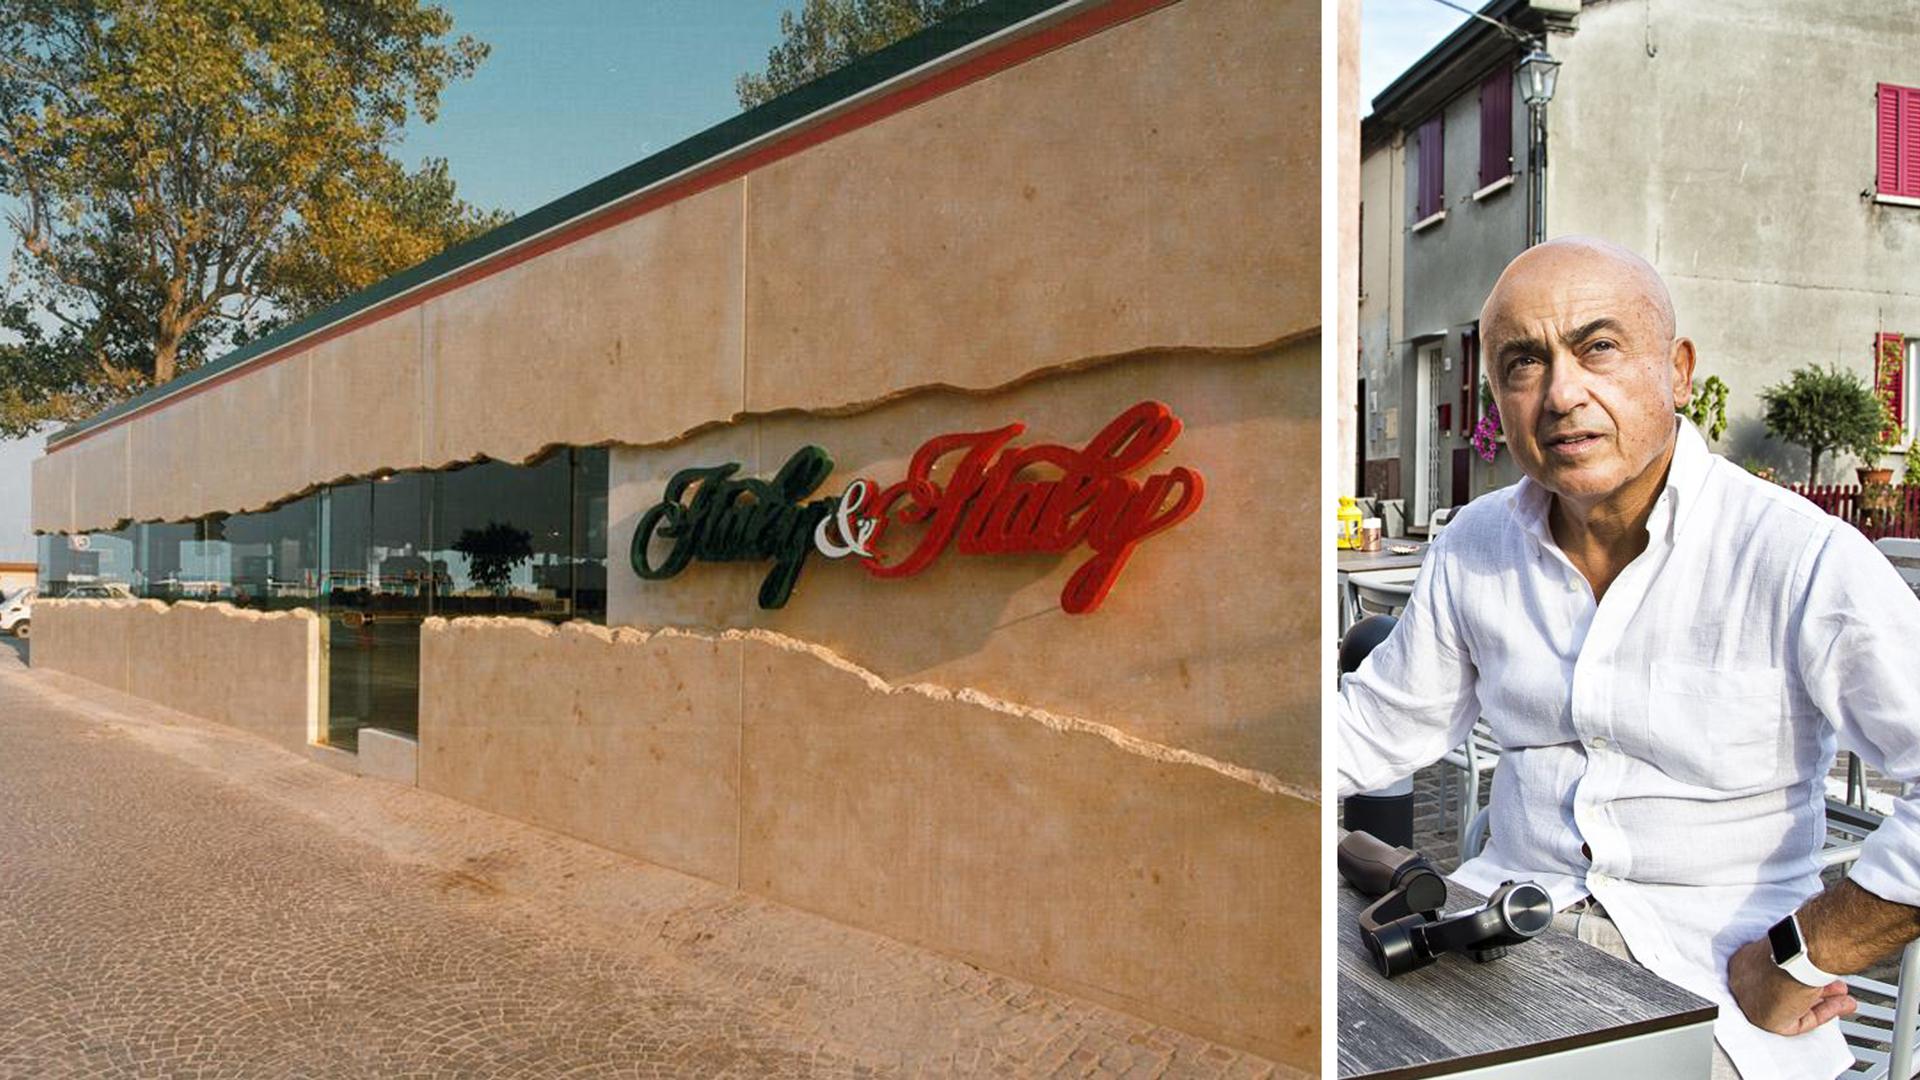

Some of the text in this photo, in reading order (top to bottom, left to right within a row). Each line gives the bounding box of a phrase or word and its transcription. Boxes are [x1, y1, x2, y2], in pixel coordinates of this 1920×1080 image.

[631, 401, 1204, 614] Italy & Italy
